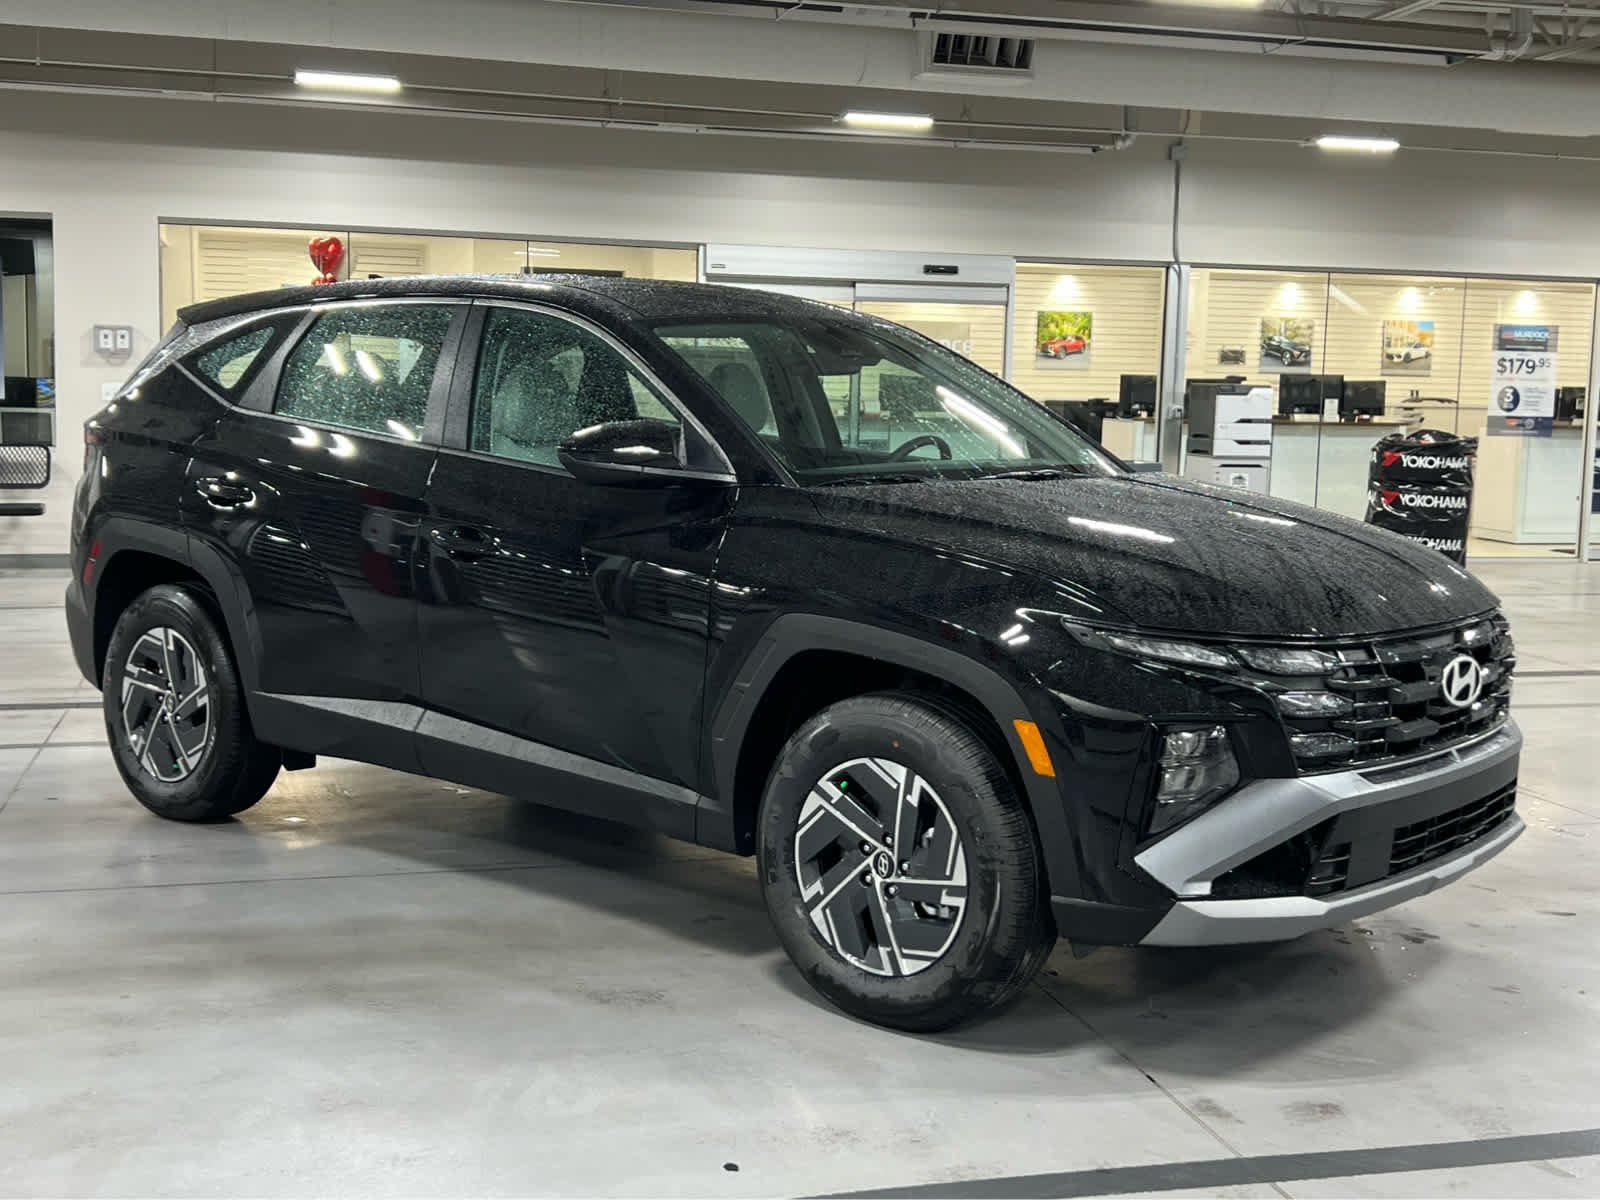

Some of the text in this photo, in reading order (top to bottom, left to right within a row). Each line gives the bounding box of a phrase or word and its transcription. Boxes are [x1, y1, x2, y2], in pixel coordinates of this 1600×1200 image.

[1496, 357, 1552, 375] $179.95
[1503, 387, 1514, 402] 3
[1400, 454, 1468, 469] YOKOHAMA
[1399, 494, 1467, 508] YOKOHAMA
[1407, 536, 1462, 551] OHAMA
